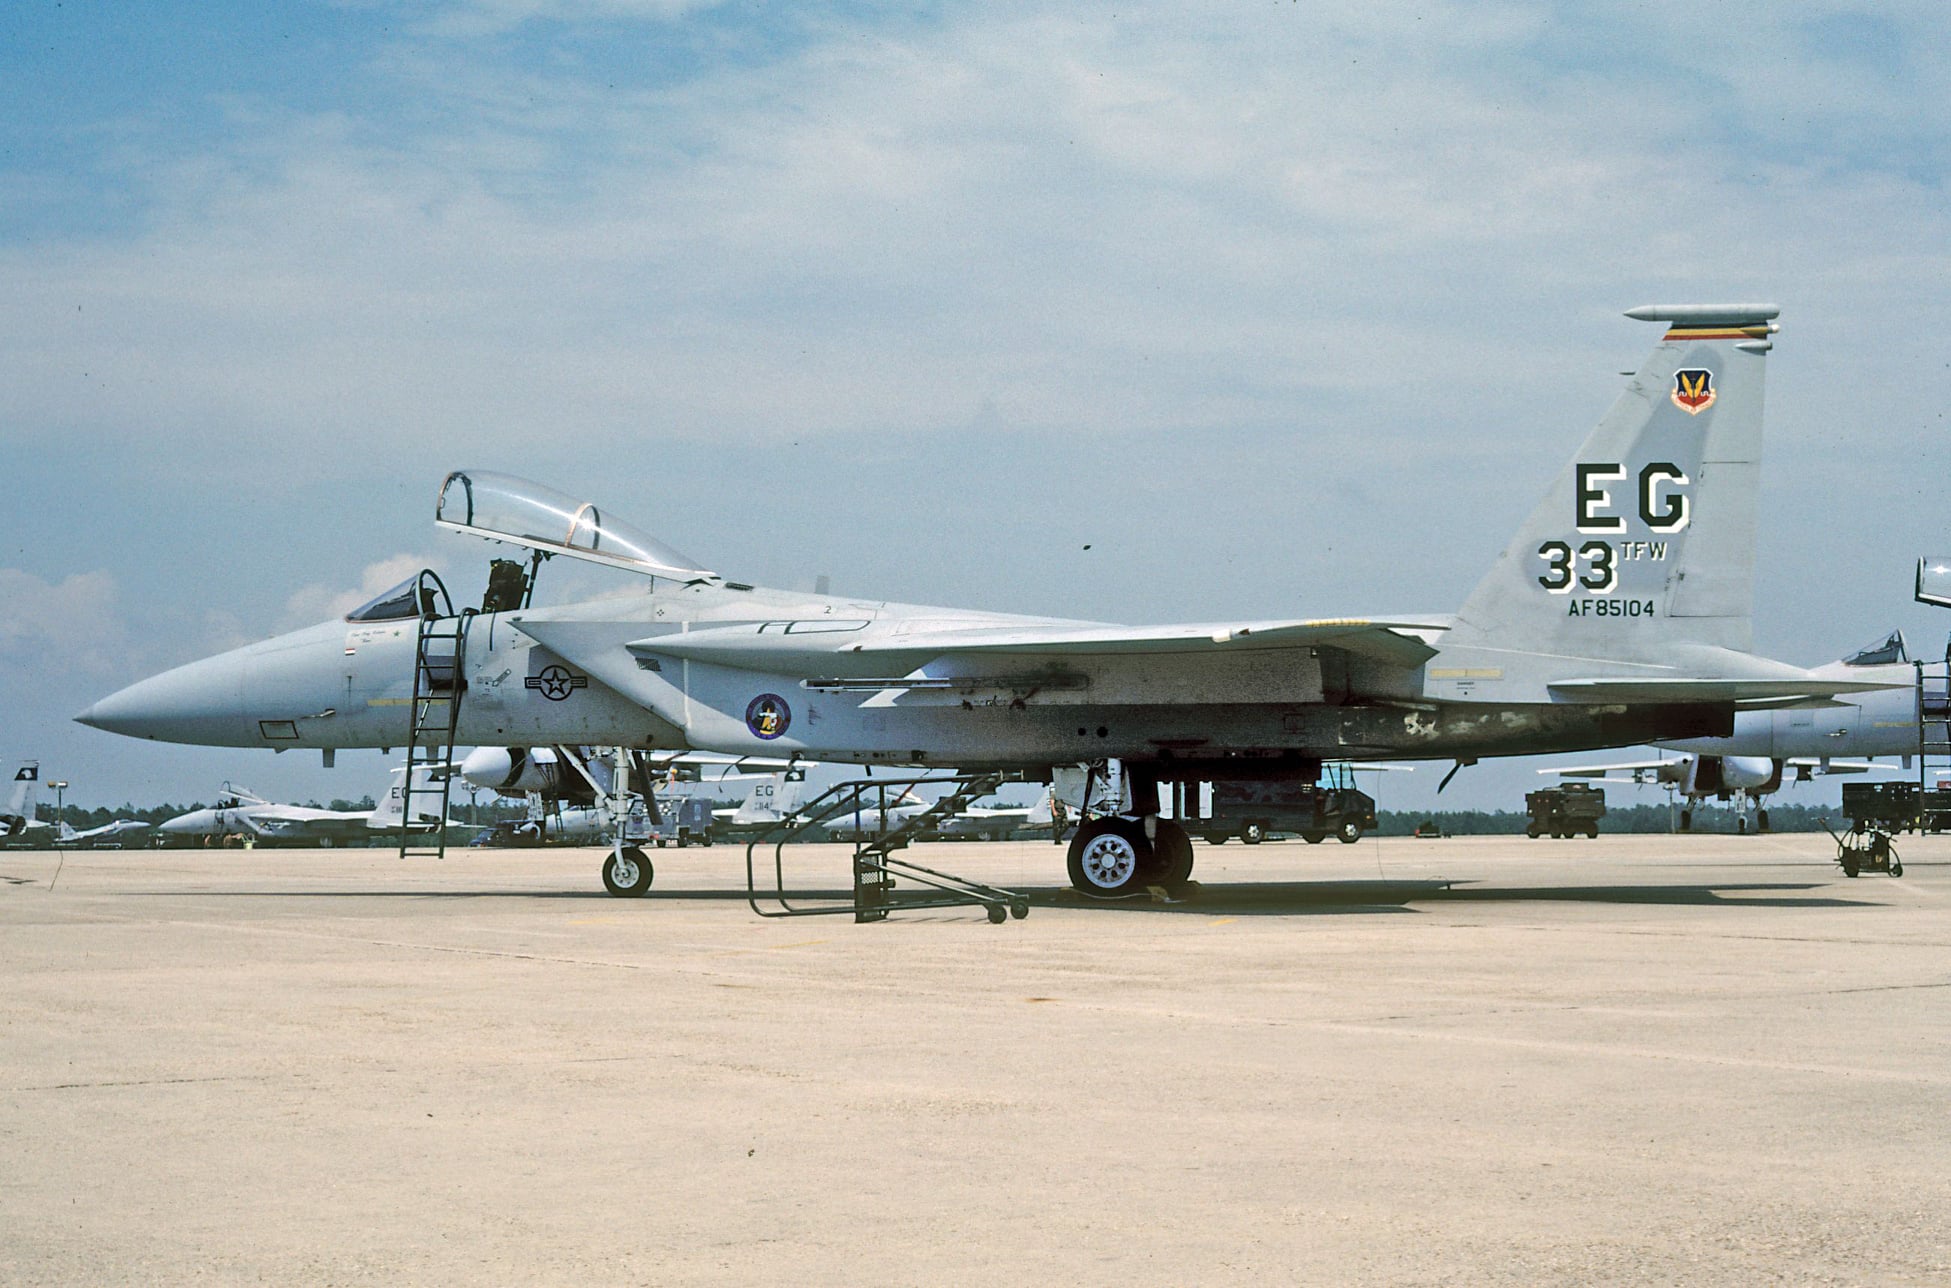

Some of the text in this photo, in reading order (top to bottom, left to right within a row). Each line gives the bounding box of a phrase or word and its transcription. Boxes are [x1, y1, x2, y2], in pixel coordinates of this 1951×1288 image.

[1576, 463, 1689, 533] EG
[1538, 541, 1667, 594] 33 TFW
[1568, 599, 1654, 617] AF85104
[755, 785, 774, 796] EG
